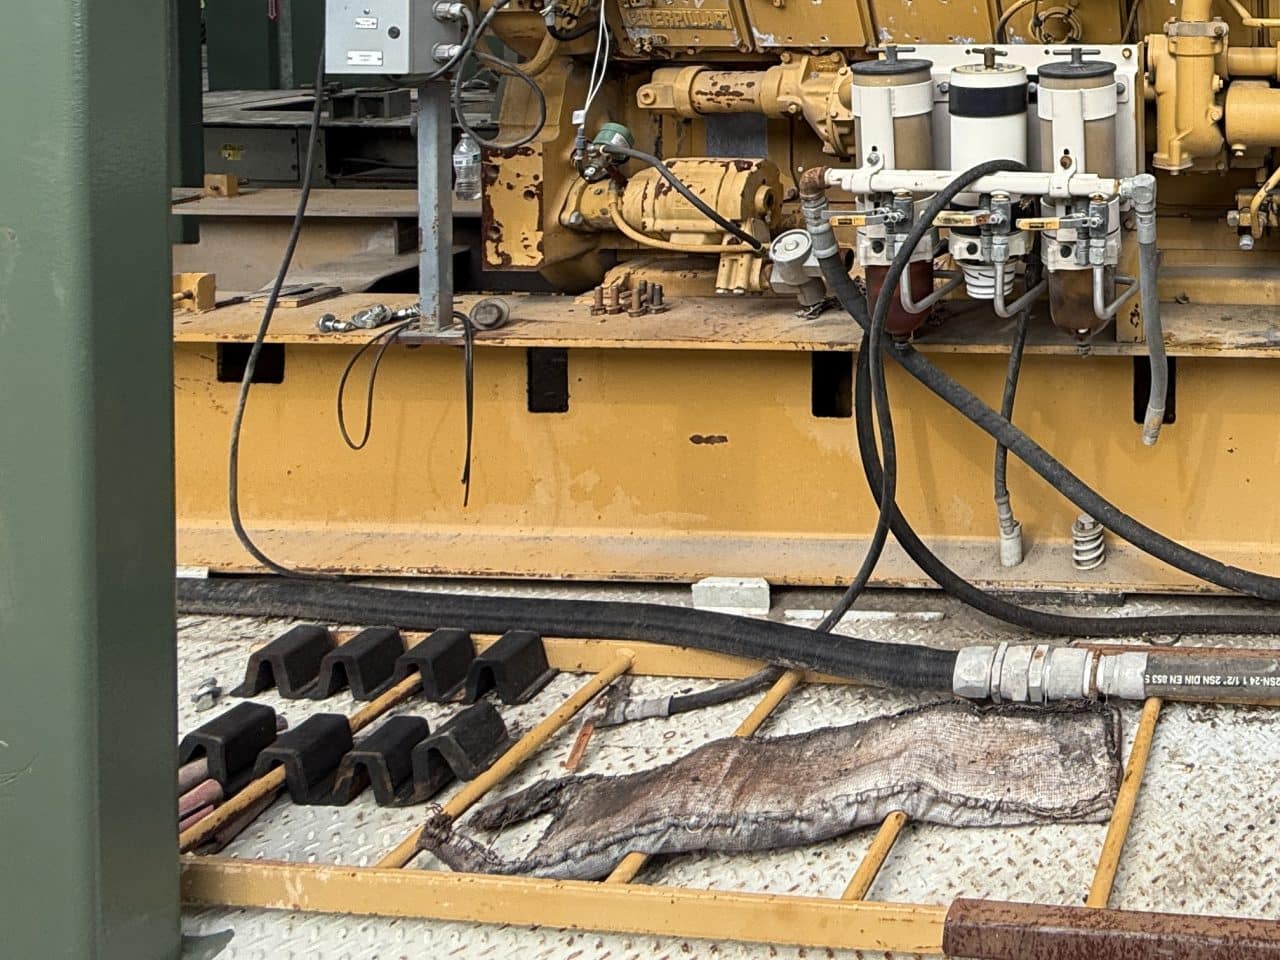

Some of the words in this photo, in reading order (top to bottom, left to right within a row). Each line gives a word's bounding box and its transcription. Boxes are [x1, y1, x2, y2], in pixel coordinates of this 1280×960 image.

[1152, 674, 1168, 685] 853
[1169, 675, 1182, 685] EN
[1184, 675, 1200, 685] DIN
[1203, 675, 1221, 685] 2SN
